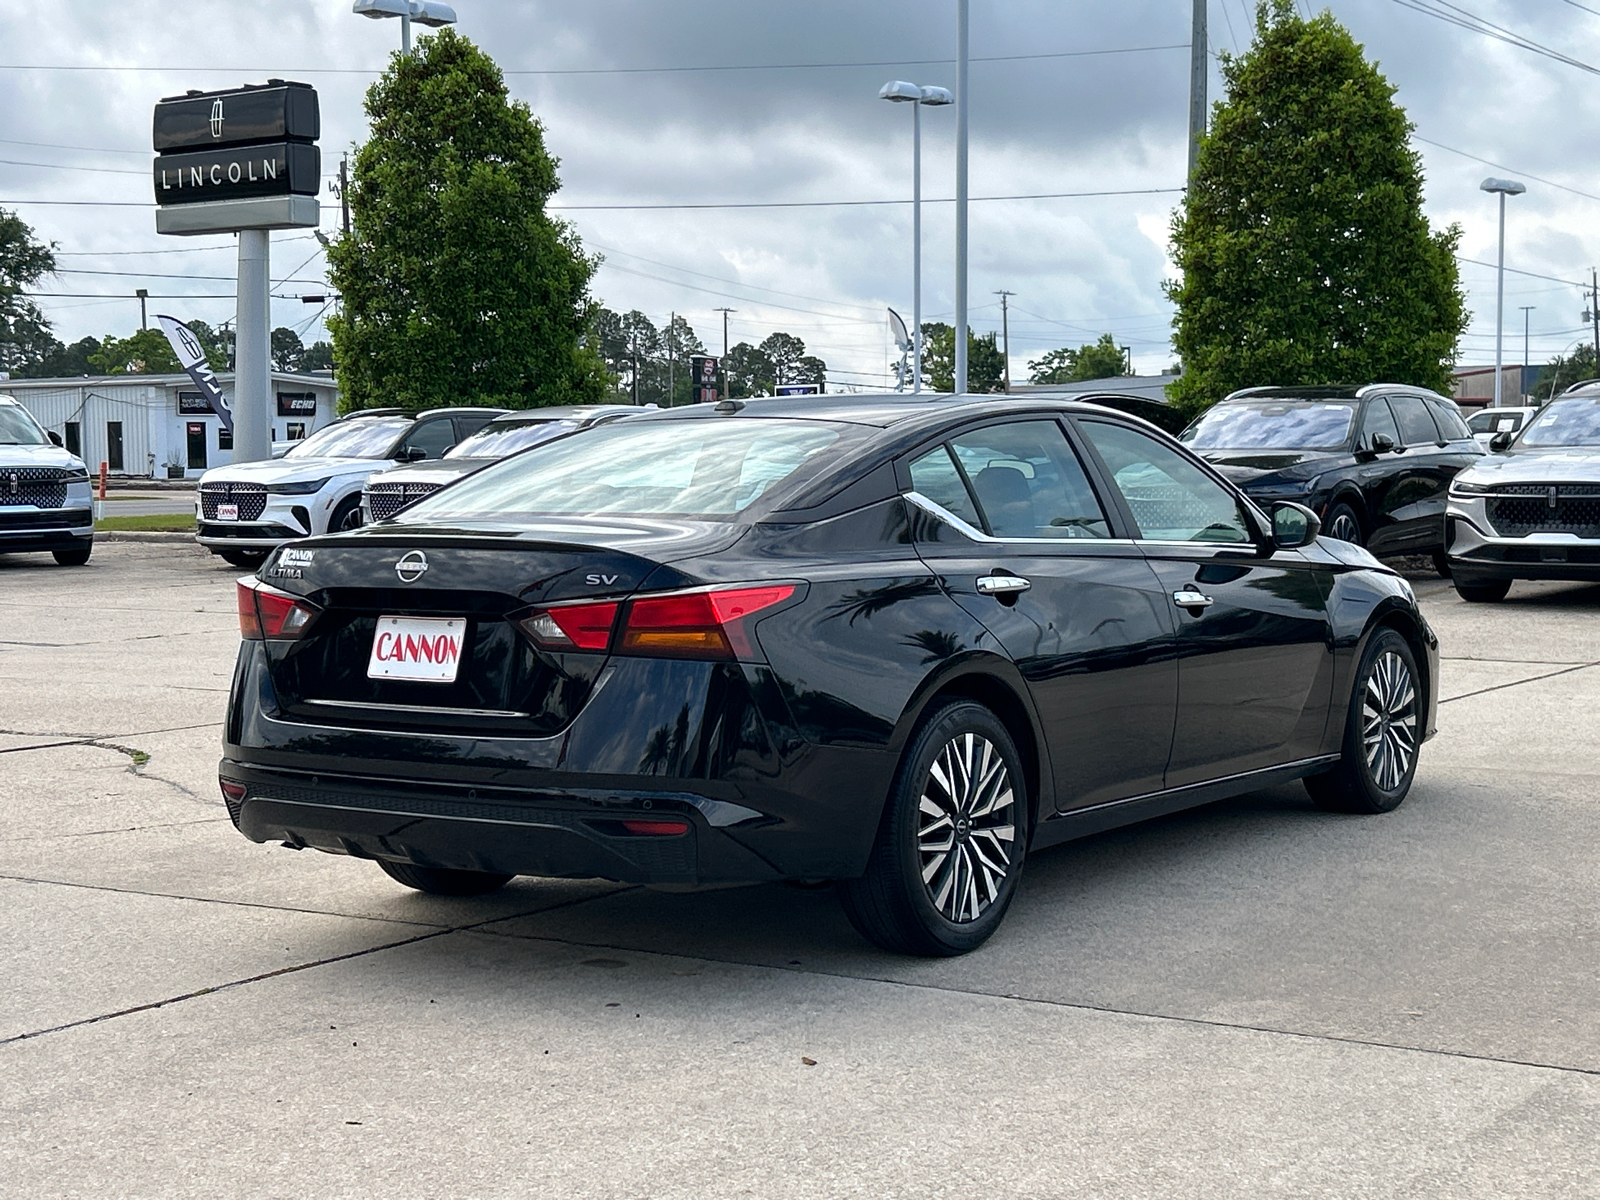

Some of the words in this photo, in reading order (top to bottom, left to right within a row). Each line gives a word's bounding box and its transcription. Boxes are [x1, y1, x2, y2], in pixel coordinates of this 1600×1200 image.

[162, 158, 277, 190] LINCOLN
[290, 399, 315, 409] ECHO
[267, 568, 303, 579] ALTIMA
[585, 574, 619, 586] SV
[376, 631, 462, 665] CANNON
